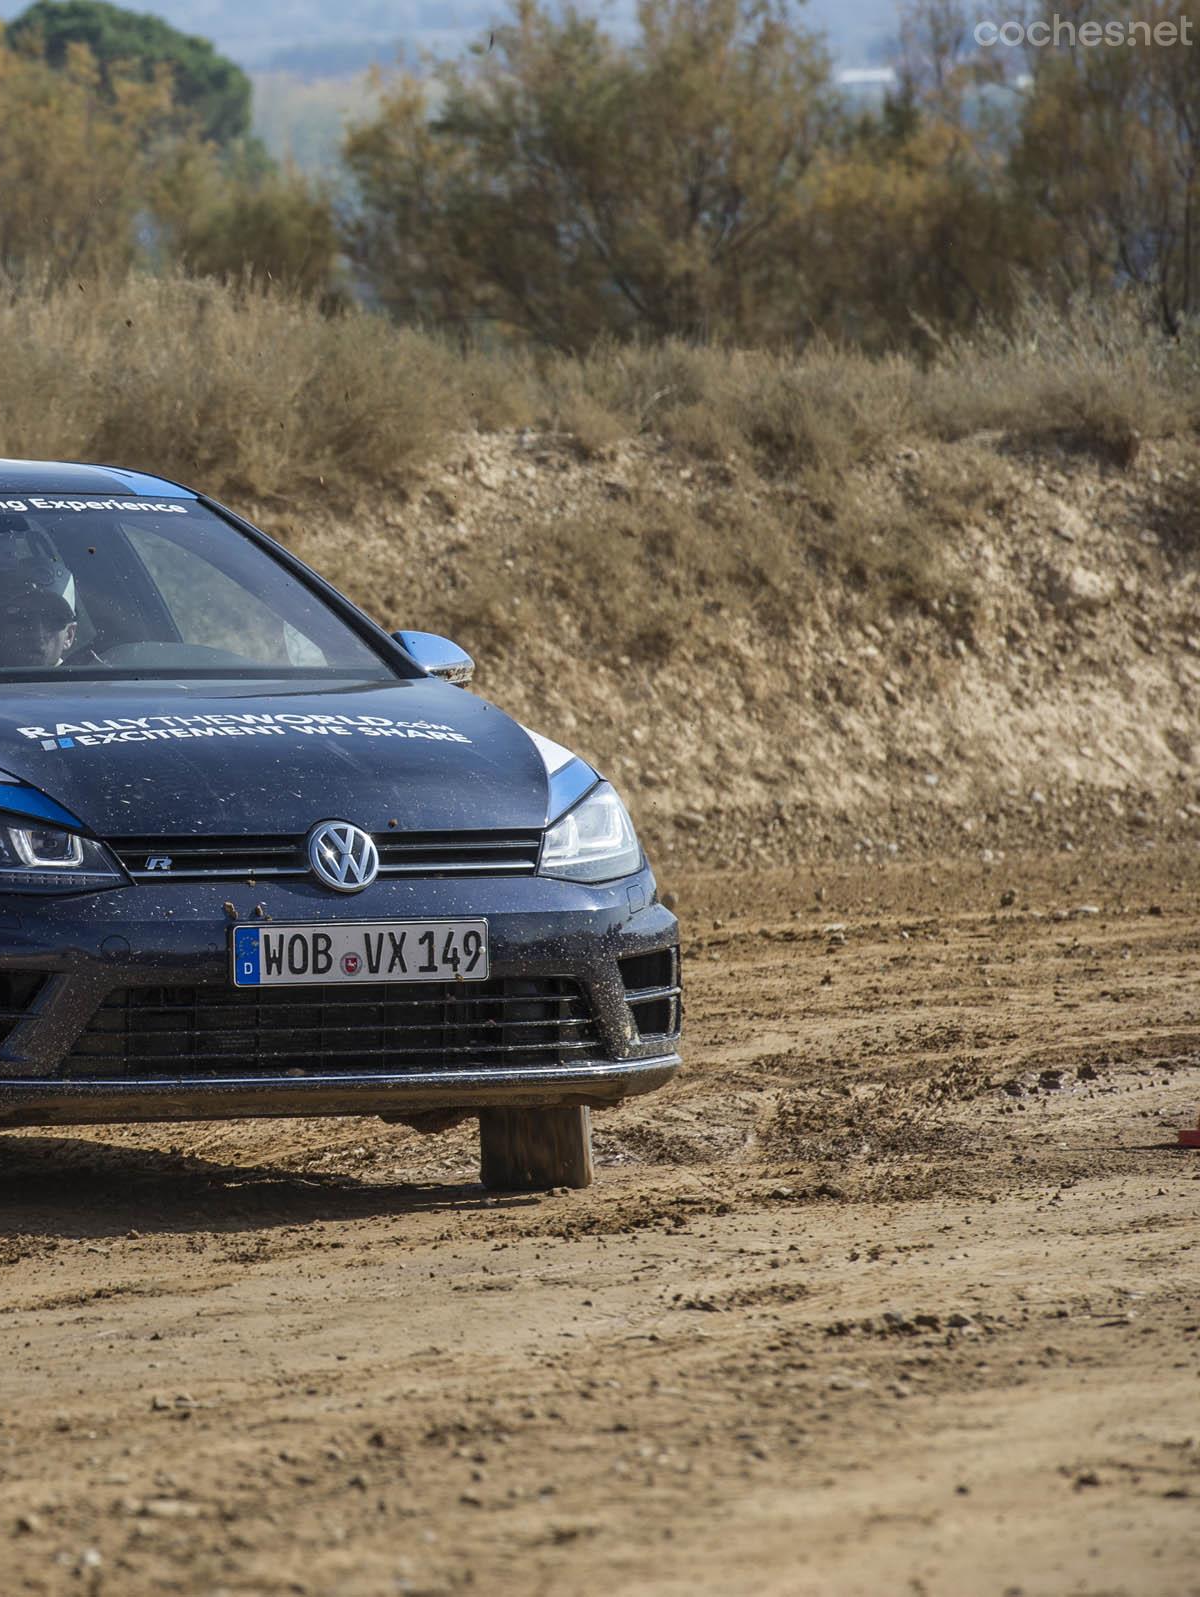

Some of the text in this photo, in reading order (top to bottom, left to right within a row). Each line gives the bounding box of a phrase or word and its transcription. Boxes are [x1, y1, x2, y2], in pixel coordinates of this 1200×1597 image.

[28, 498, 189, 514] Experience
[75, 725, 473, 746] EXCITEMENT WE SHARE
[145, 856, 172, 870] R
[243, 930, 482, 976] D WOB VX 149
